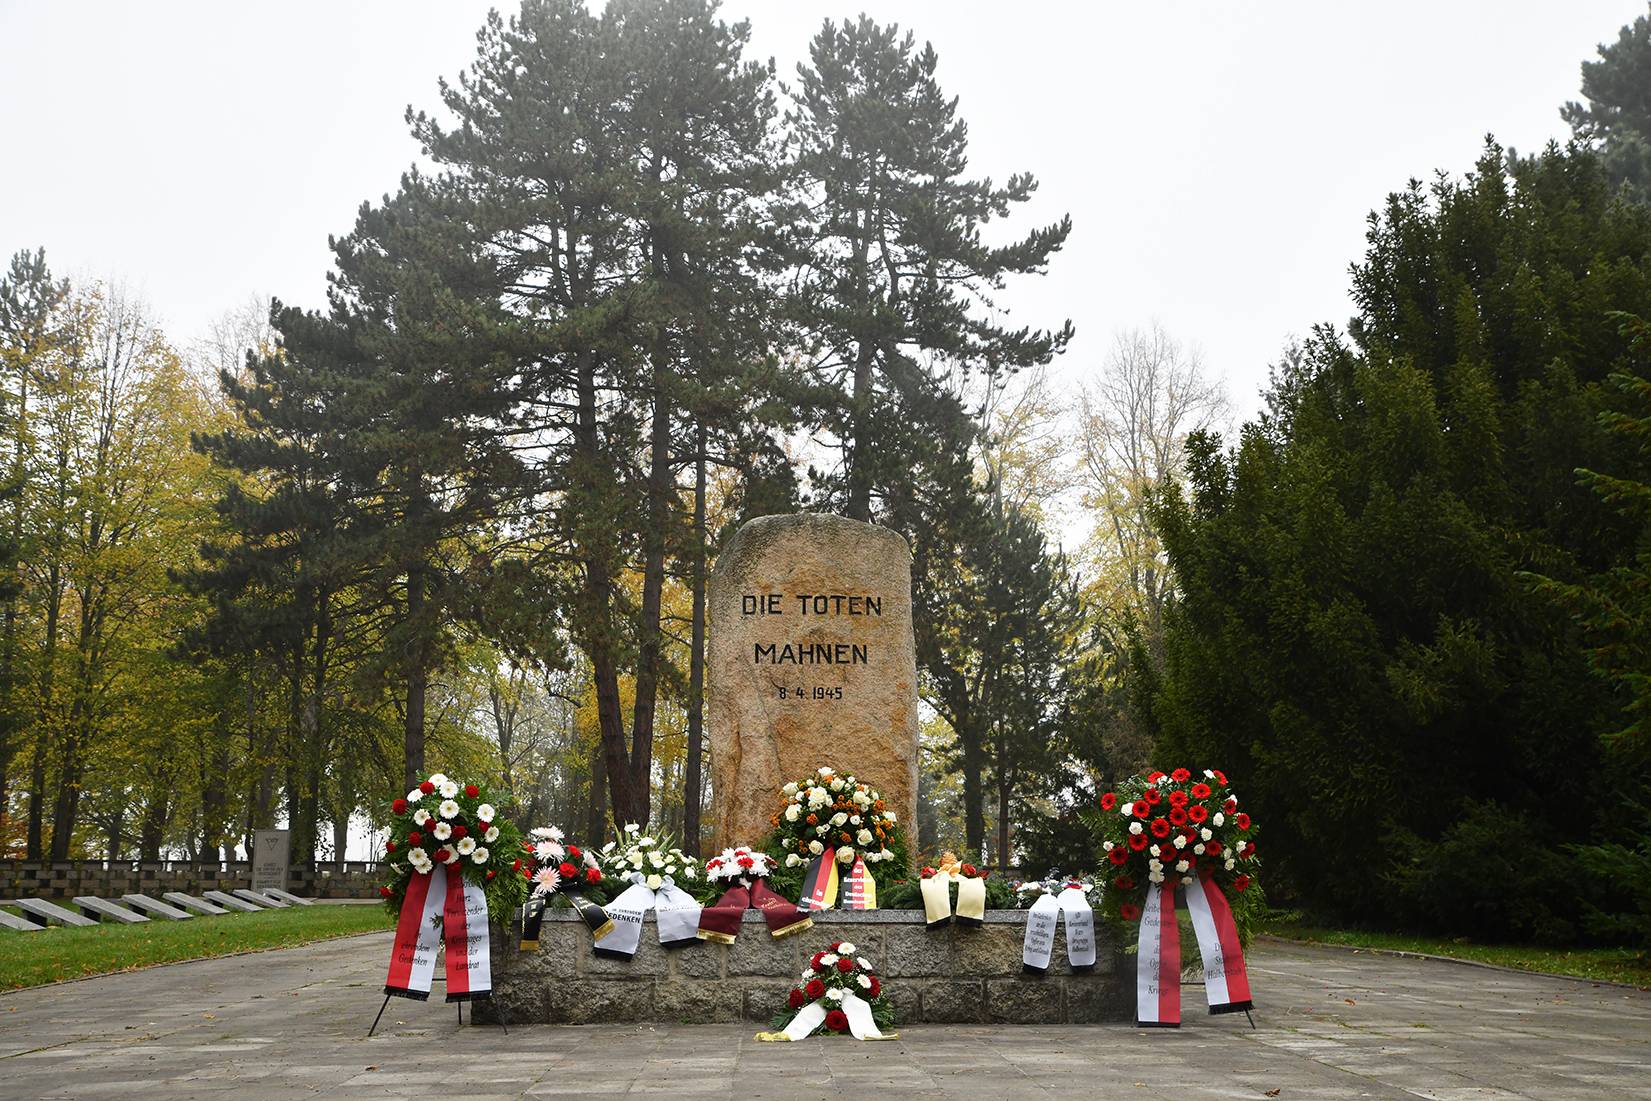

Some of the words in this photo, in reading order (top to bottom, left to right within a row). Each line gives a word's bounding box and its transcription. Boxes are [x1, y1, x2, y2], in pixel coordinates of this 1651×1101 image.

[742, 595, 783, 615] DIE
[796, 595, 882, 616] TOTEN
[754, 643, 868, 665] MAHNEN
[813, 687, 843, 699] 1945
